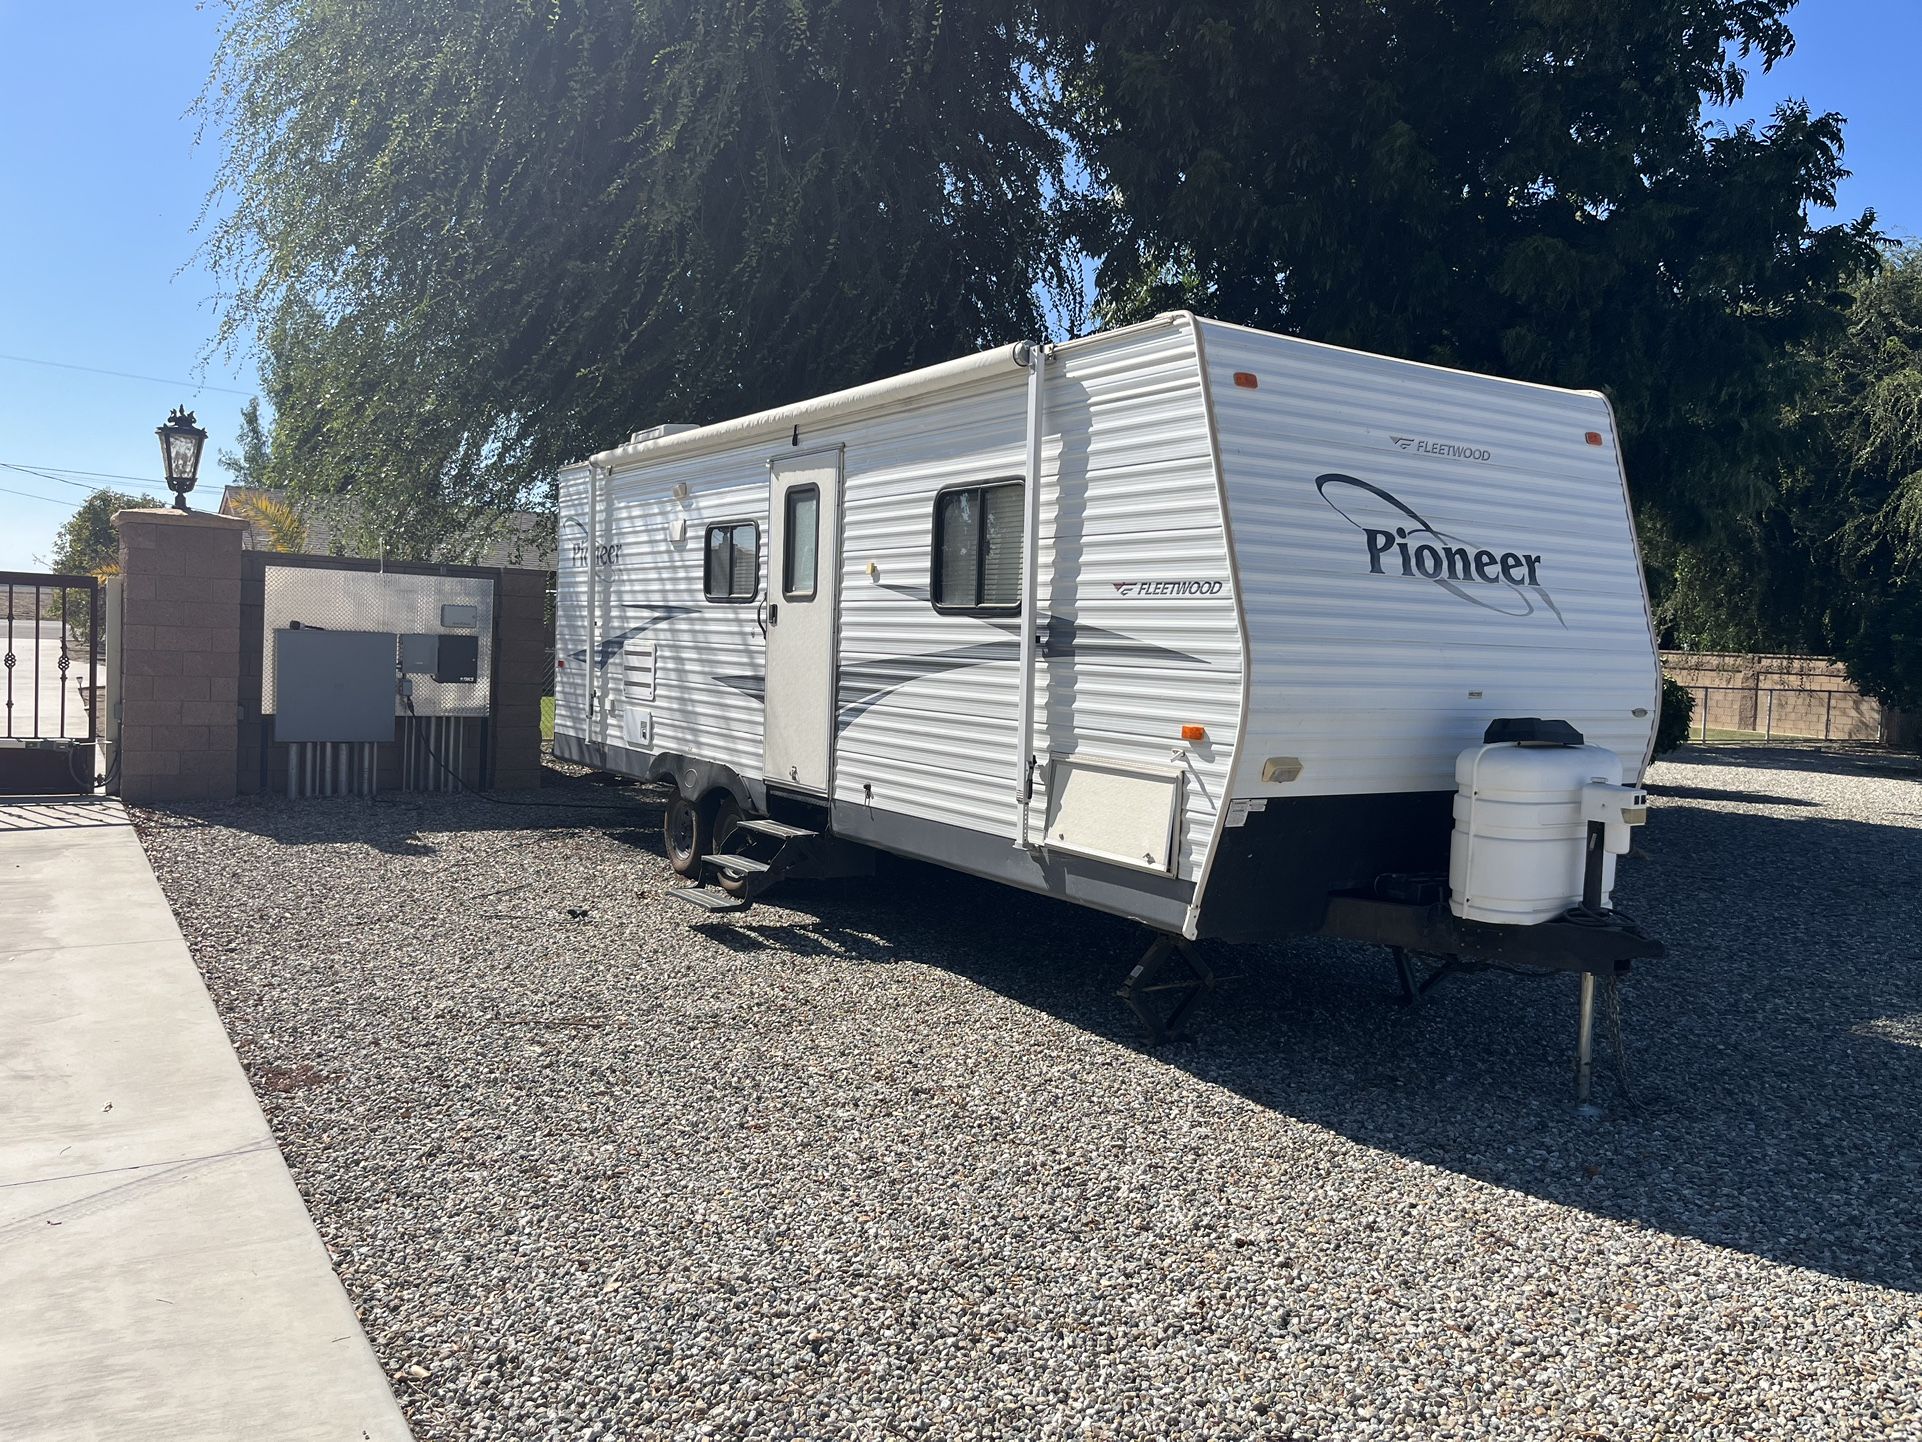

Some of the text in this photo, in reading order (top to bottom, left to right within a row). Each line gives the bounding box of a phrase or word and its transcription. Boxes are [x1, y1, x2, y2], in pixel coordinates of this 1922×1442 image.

[1416, 440, 1491, 461] FLEETWOOD
[1362, 526, 1541, 587] Pioneer
[1137, 581, 1223, 595] FLEETWOOD
